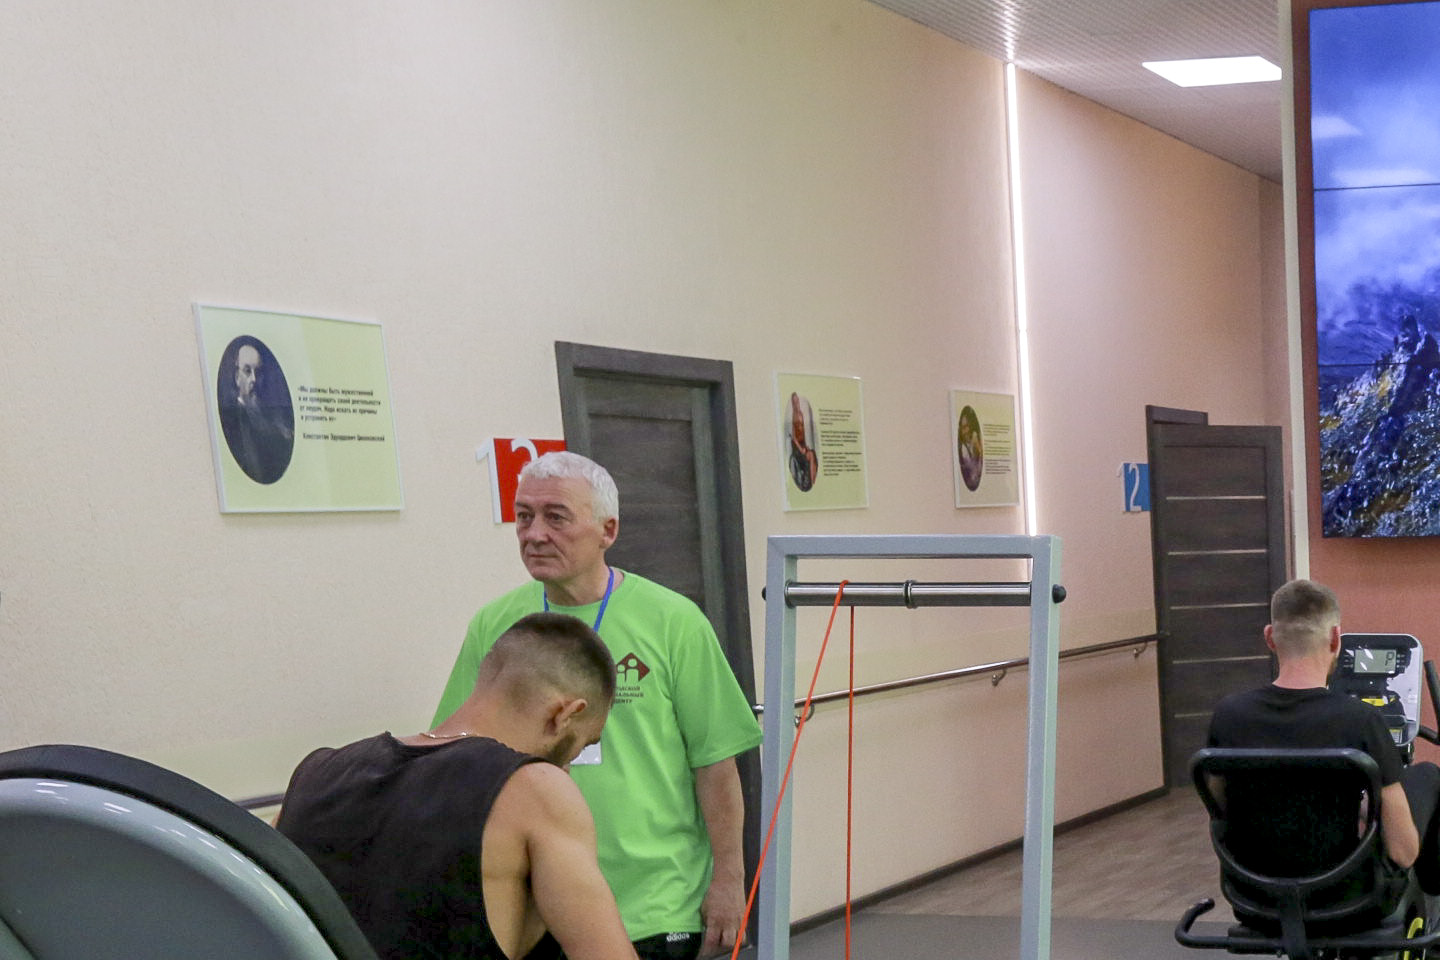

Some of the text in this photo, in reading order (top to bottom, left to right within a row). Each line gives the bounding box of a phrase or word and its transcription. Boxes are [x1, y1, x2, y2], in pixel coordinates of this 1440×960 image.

[303, 432, 385, 442] Константин Эдуардович Циолковский
[1116, 462, 1142, 512] 12
